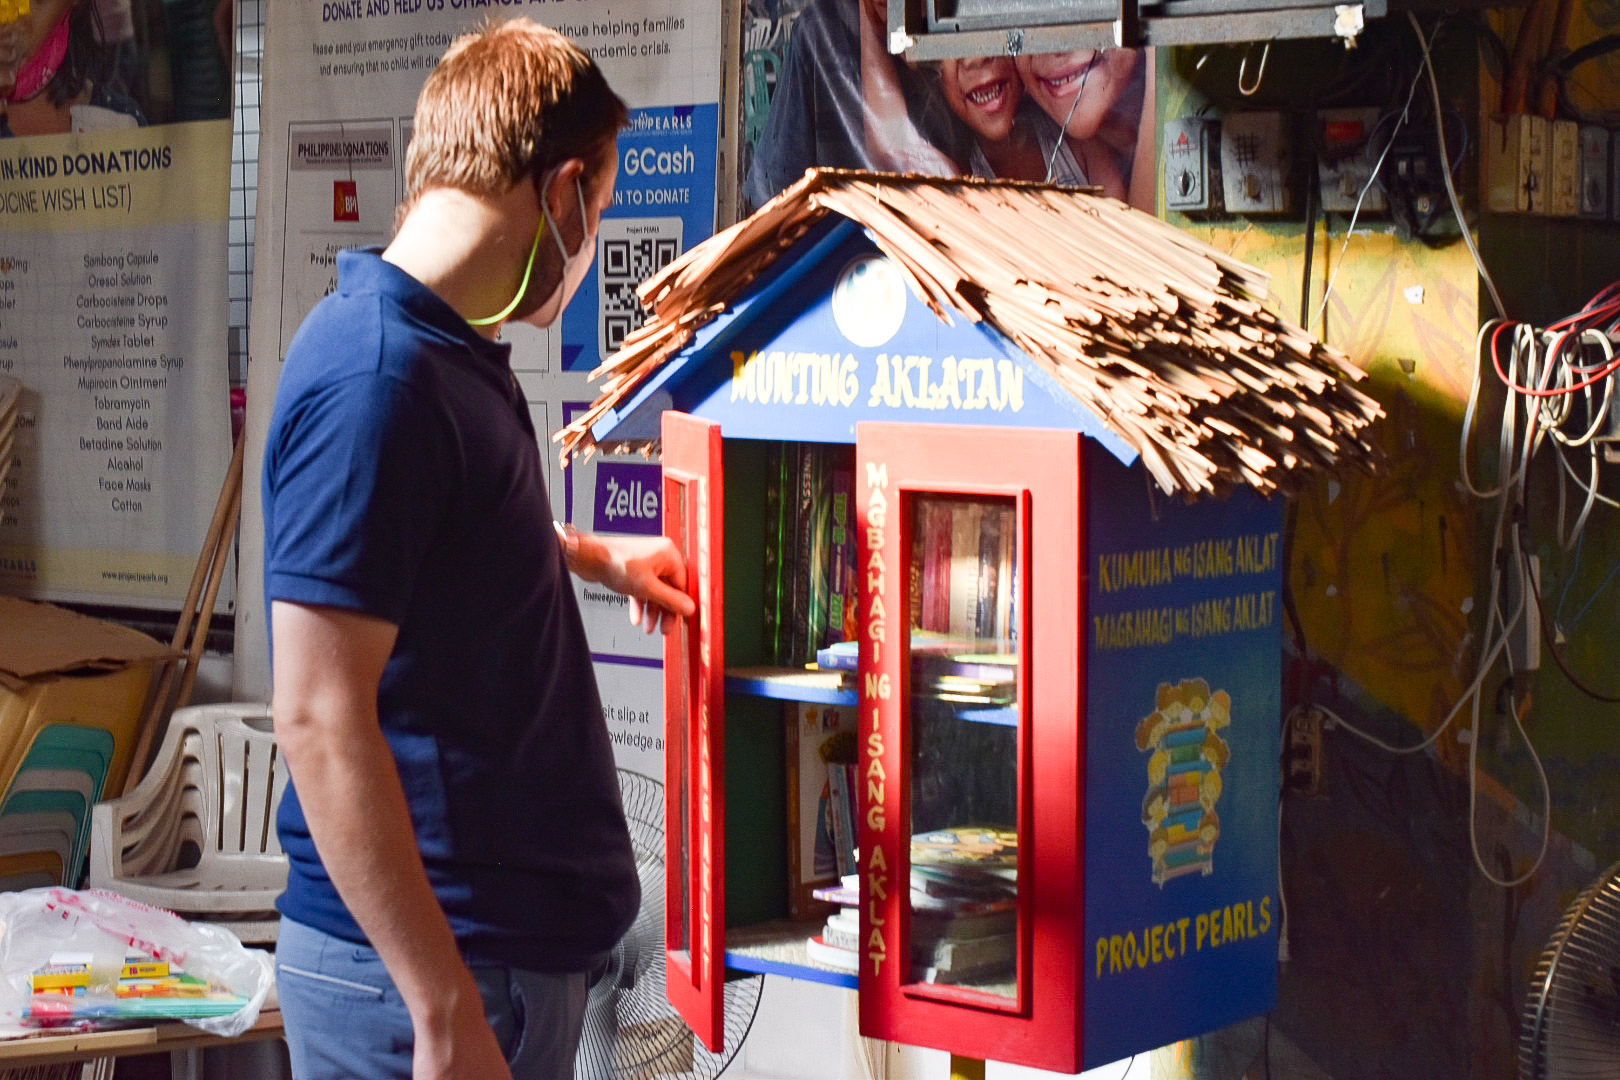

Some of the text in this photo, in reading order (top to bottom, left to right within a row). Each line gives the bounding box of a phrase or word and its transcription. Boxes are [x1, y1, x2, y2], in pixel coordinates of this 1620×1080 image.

[322, 2, 362, 22] DONATE
[366, 0, 390, 17] AND
[394, 0, 421, 14] HELP
[335, 40, 352, 54] send
[352, 42, 367, 56] your
[368, 37, 408, 52] emergency
[409, 32, 424, 51] gift
[425, 31, 452, 48] today
[592, 19, 639, 38] helping
[643, 16, 685, 33] families
[333, 60, 365, 77] ensuring
[366, 59, 379, 73] that
[380, 61, 390, 72] no
[391, 56, 409, 71] child
[410, 55, 424, 69] will
[425, 54, 440, 69] die
[640, 40, 671, 57] crisis.
[647, 115, 692, 131] PEARLS
[342, 140, 389, 158] DONATIONS
[1, 145, 172, 180] IN-KIND DONATIONS
[624, 144, 695, 176] GCash
[42, 186, 86, 212] WISH
[92, 182, 132, 214] LIST)
[626, 189, 642, 205] TO
[645, 187, 690, 205] DONATE
[83, 249, 159, 270] Sambong Capsule
[310, 252, 337, 268] Projec
[88, 272, 152, 288] Oresol Solution
[76, 292, 168, 310] Carbocisteine Drops
[77, 313, 168, 330] Carbocisteine Syrup
[123, 332, 154, 348] Tablet
[64, 352, 184, 373] Phenylpropanolamine Syrup
[78, 375, 167, 393] Mupirocin Ointment
[729, 350, 1025, 413] MUNTING AKLATAN
[94, 395, 151, 413] Tobramycin
[96, 416, 148, 430] Band Aide
[80, 436, 162, 451] Betadine Solution
[107, 456, 143, 471] Alcohol
[98, 477, 151, 492] Face Masks
[111, 496, 142, 512] Cotton
[604, 476, 659, 522] Zelle
[1099, 532, 1279, 593] KUMUHA NG ISANG AKLAT
[1093, 606, 1174, 649] MAGBAHAGI
[1191, 596, 1231, 638] ISANG
[1233, 590, 1276, 631] AKLAT
[617, 706, 636, 726] slip
[638, 710, 650, 723] at
[865, 462, 891, 977] MAGBAHAGI NG ISANG AKLAT
[1096, 895, 1273, 979] PROJECT PEARLS
